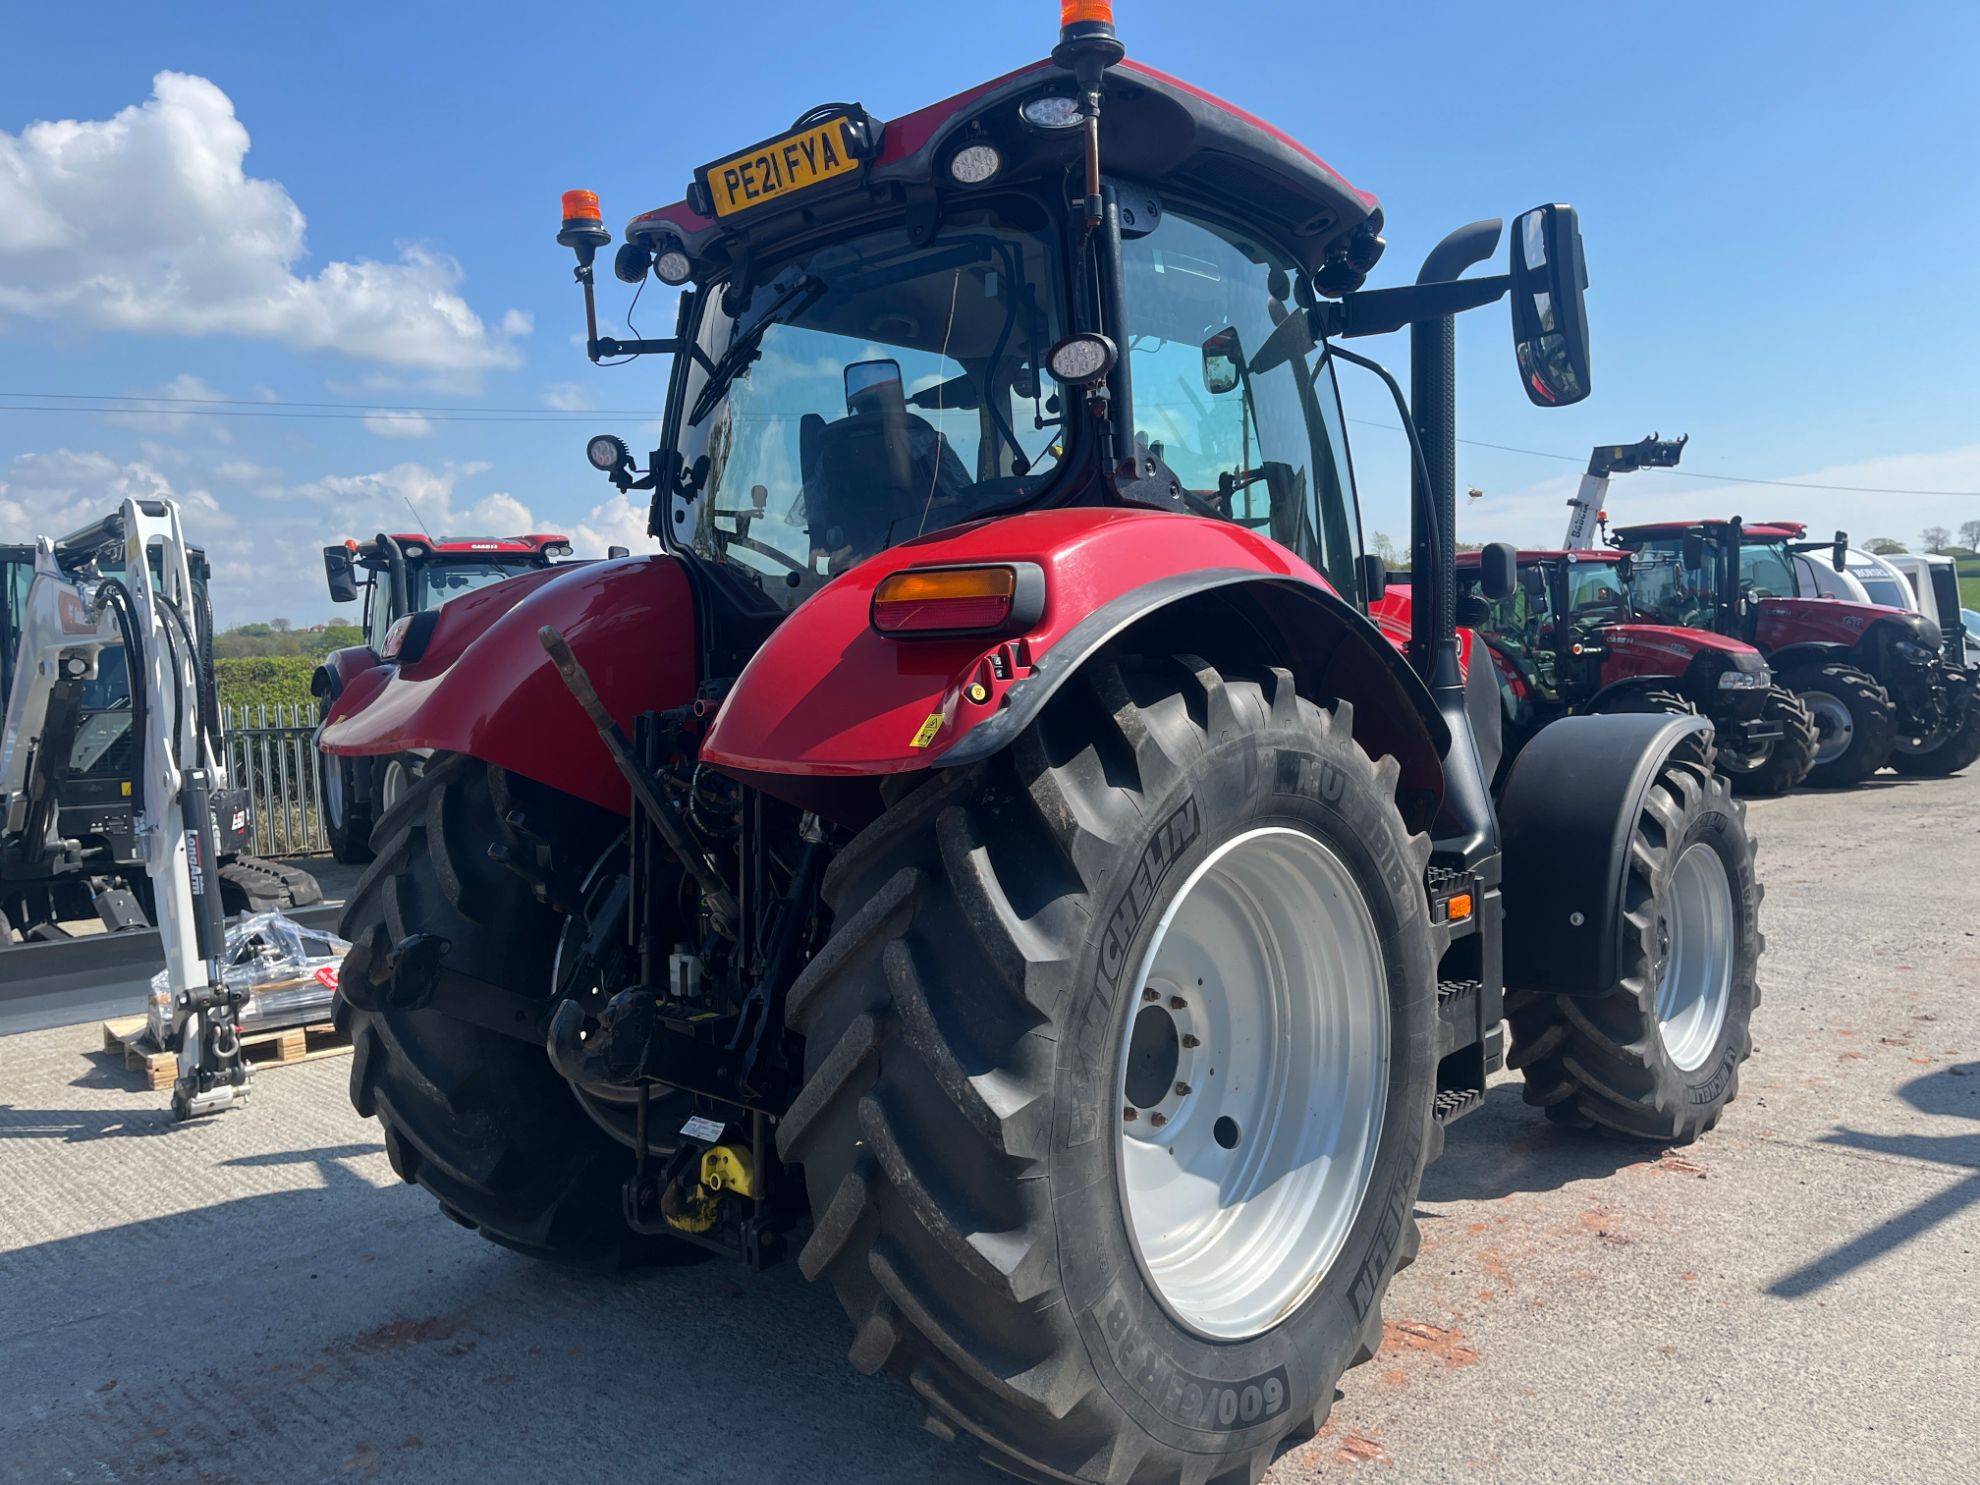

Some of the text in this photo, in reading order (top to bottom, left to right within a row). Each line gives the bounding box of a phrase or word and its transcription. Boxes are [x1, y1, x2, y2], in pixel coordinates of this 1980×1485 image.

[723, 131, 840, 205] PE21 FYA
[184, 829, 203, 896] LongArm
[1078, 804, 1198, 1031] MICHELIN
